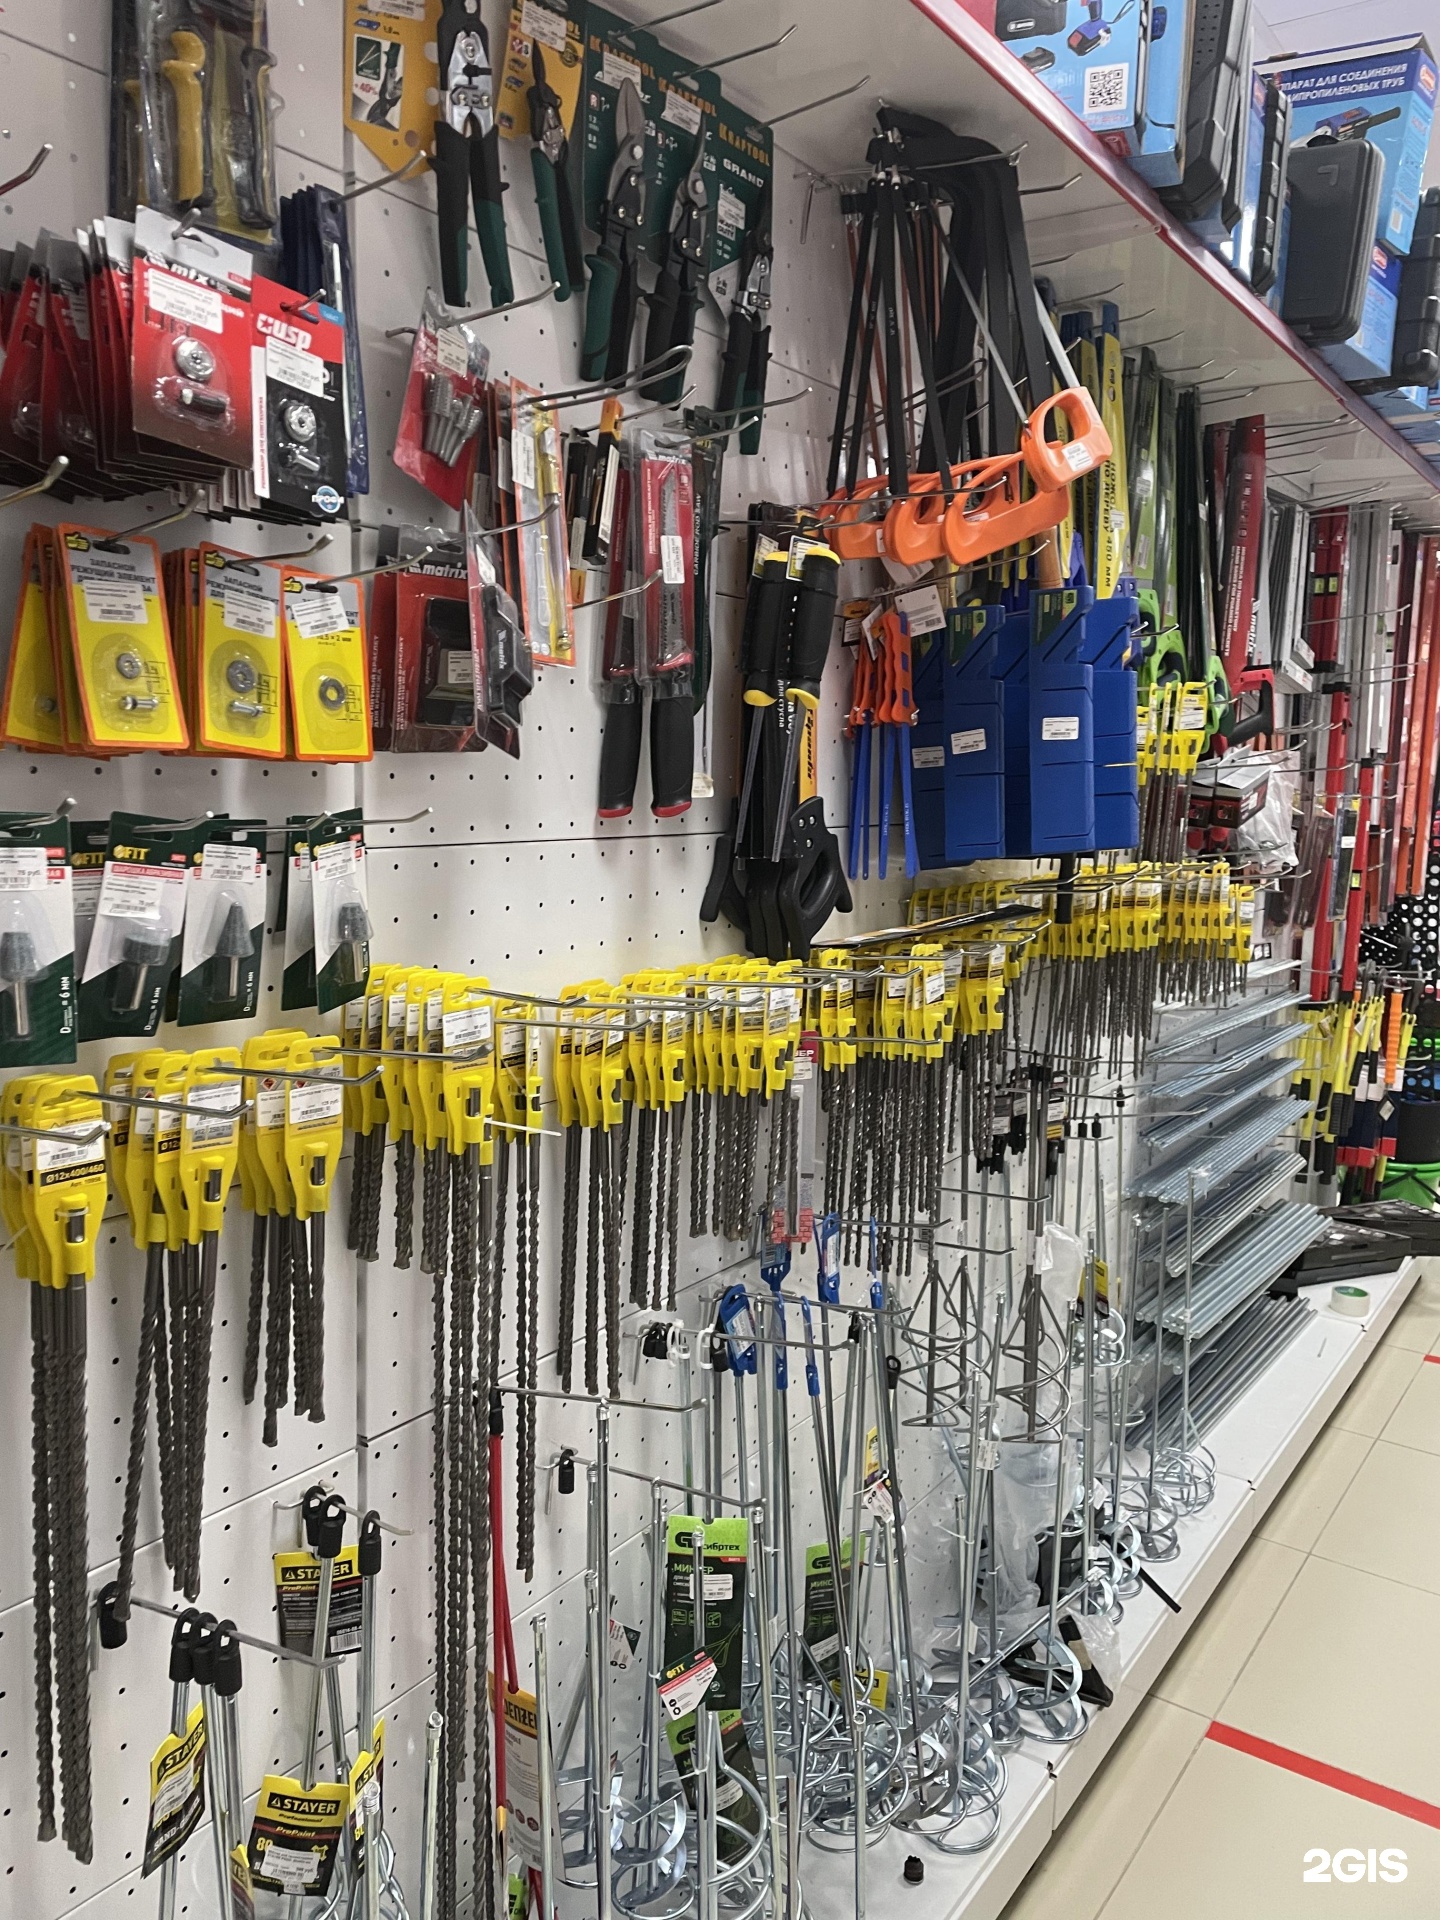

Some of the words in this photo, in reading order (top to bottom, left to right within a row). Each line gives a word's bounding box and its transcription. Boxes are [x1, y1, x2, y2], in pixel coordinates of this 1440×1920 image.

[1315, 74, 1336, 87] ДЛЯ
[1338, 63, 1408, 83] СОЕДИНЕНИЯ
[1382, 77, 1405, 89] ТРУБ
[719, 123, 770, 167] KRAFTOOL
[723, 158, 764, 188] GRAND
[171, 263, 209, 286] mtx
[1105, 536, 1113, 562] 450
[90, 559, 136, 571] ЗАПАСНОЙ
[422, 562, 467, 579] matrix
[117, 572, 156, 583] ЭЛЕМЕНТ
[223, 576, 263, 592] ЗАПАСНОЙ
[1248, 614, 1257, 653] matrix
[499, 641, 507, 669] matrix
[777, 698, 785, 728] стусла
[124, 847, 150, 860] FIT
[702, 1542, 740, 1551] сибртех
[297, 1563, 350, 1580] STAER
[672, 1663, 686, 1676] FIT
[283, 1798, 337, 1814] STAYER
[278, 1813, 323, 1822] Professional
[275, 1826, 316, 1838] ProPaint
